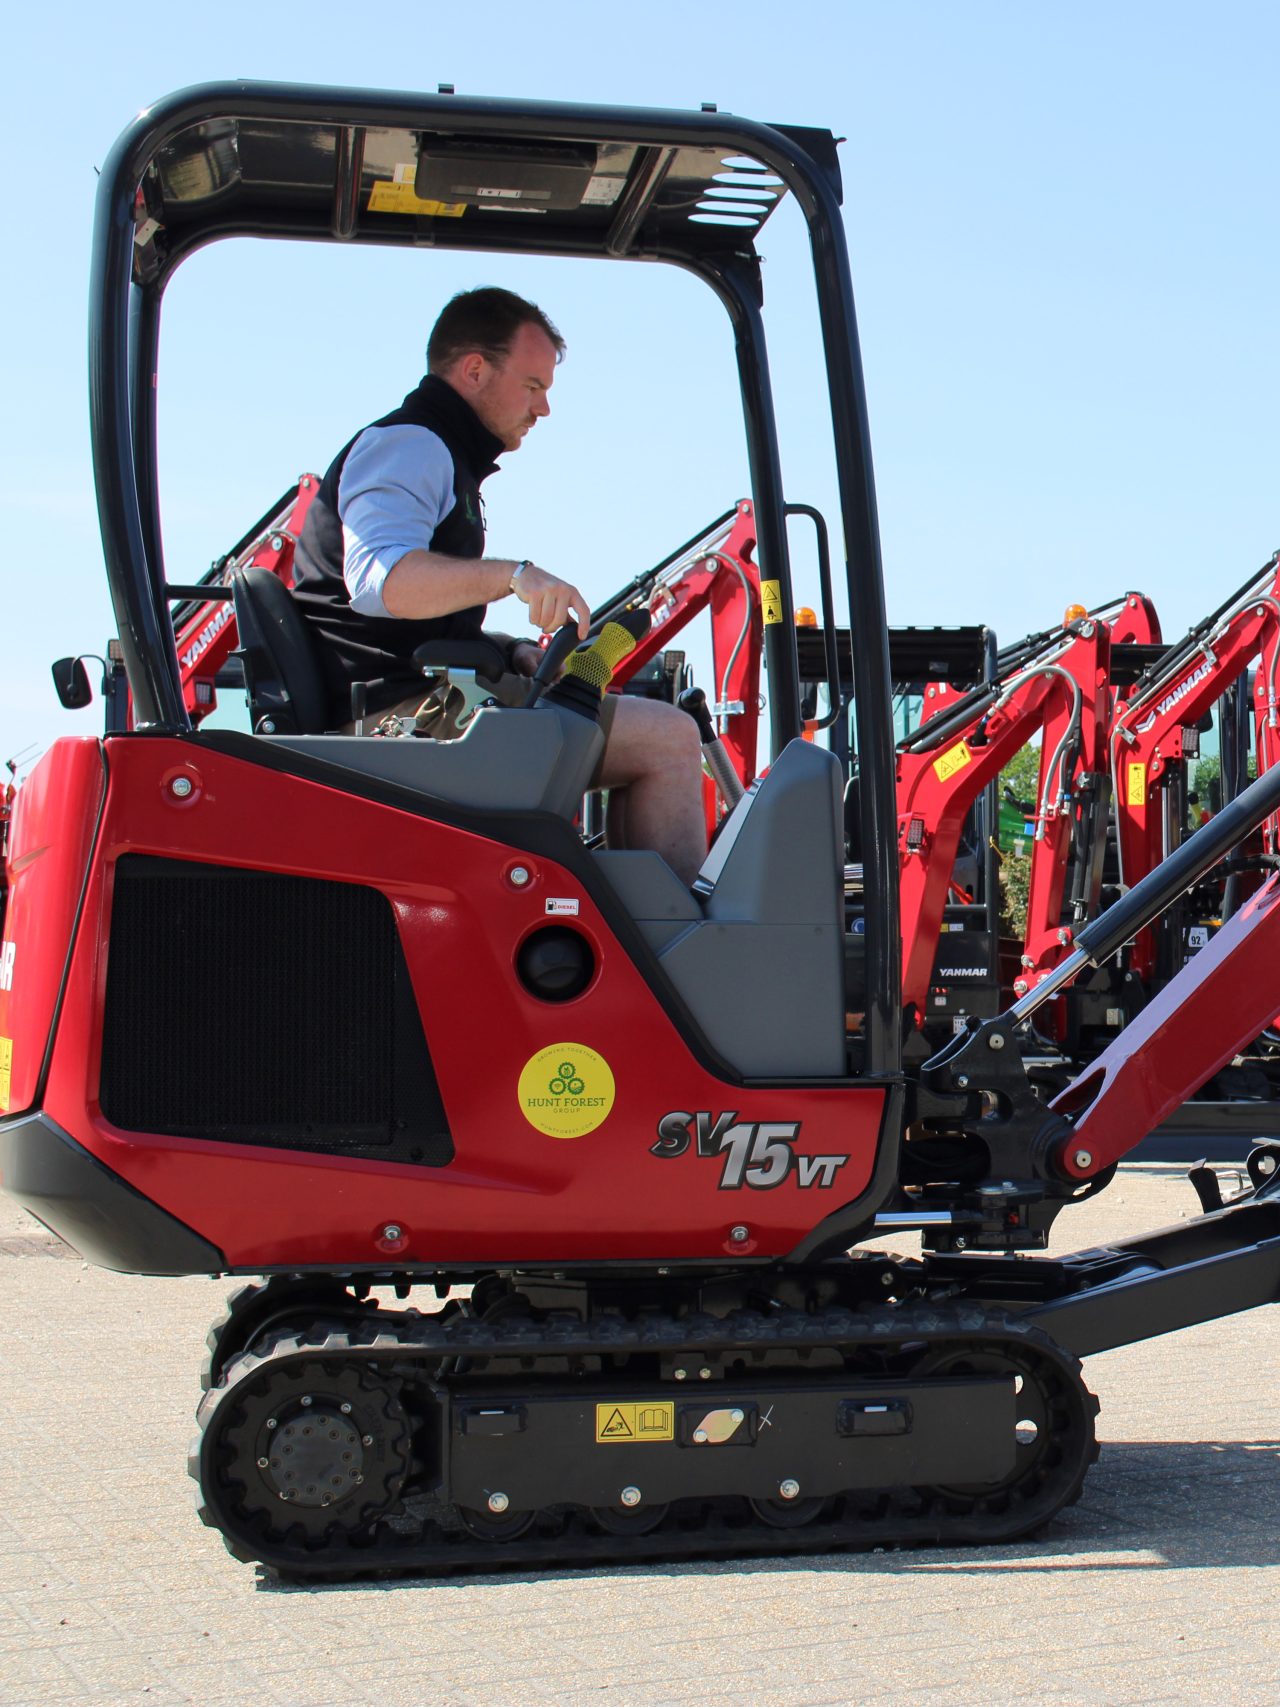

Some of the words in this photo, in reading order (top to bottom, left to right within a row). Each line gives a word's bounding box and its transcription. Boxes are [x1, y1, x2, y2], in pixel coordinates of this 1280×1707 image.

[181, 601, 236, 668] YANMA
[1157, 661, 1214, 716] YANMAR
[1191, 935, 1201, 945] 92
[940, 968, 987, 976] YANMAR
[528, 1098, 561, 1107] HUNT
[564, 1098, 606, 1107] FOREST
